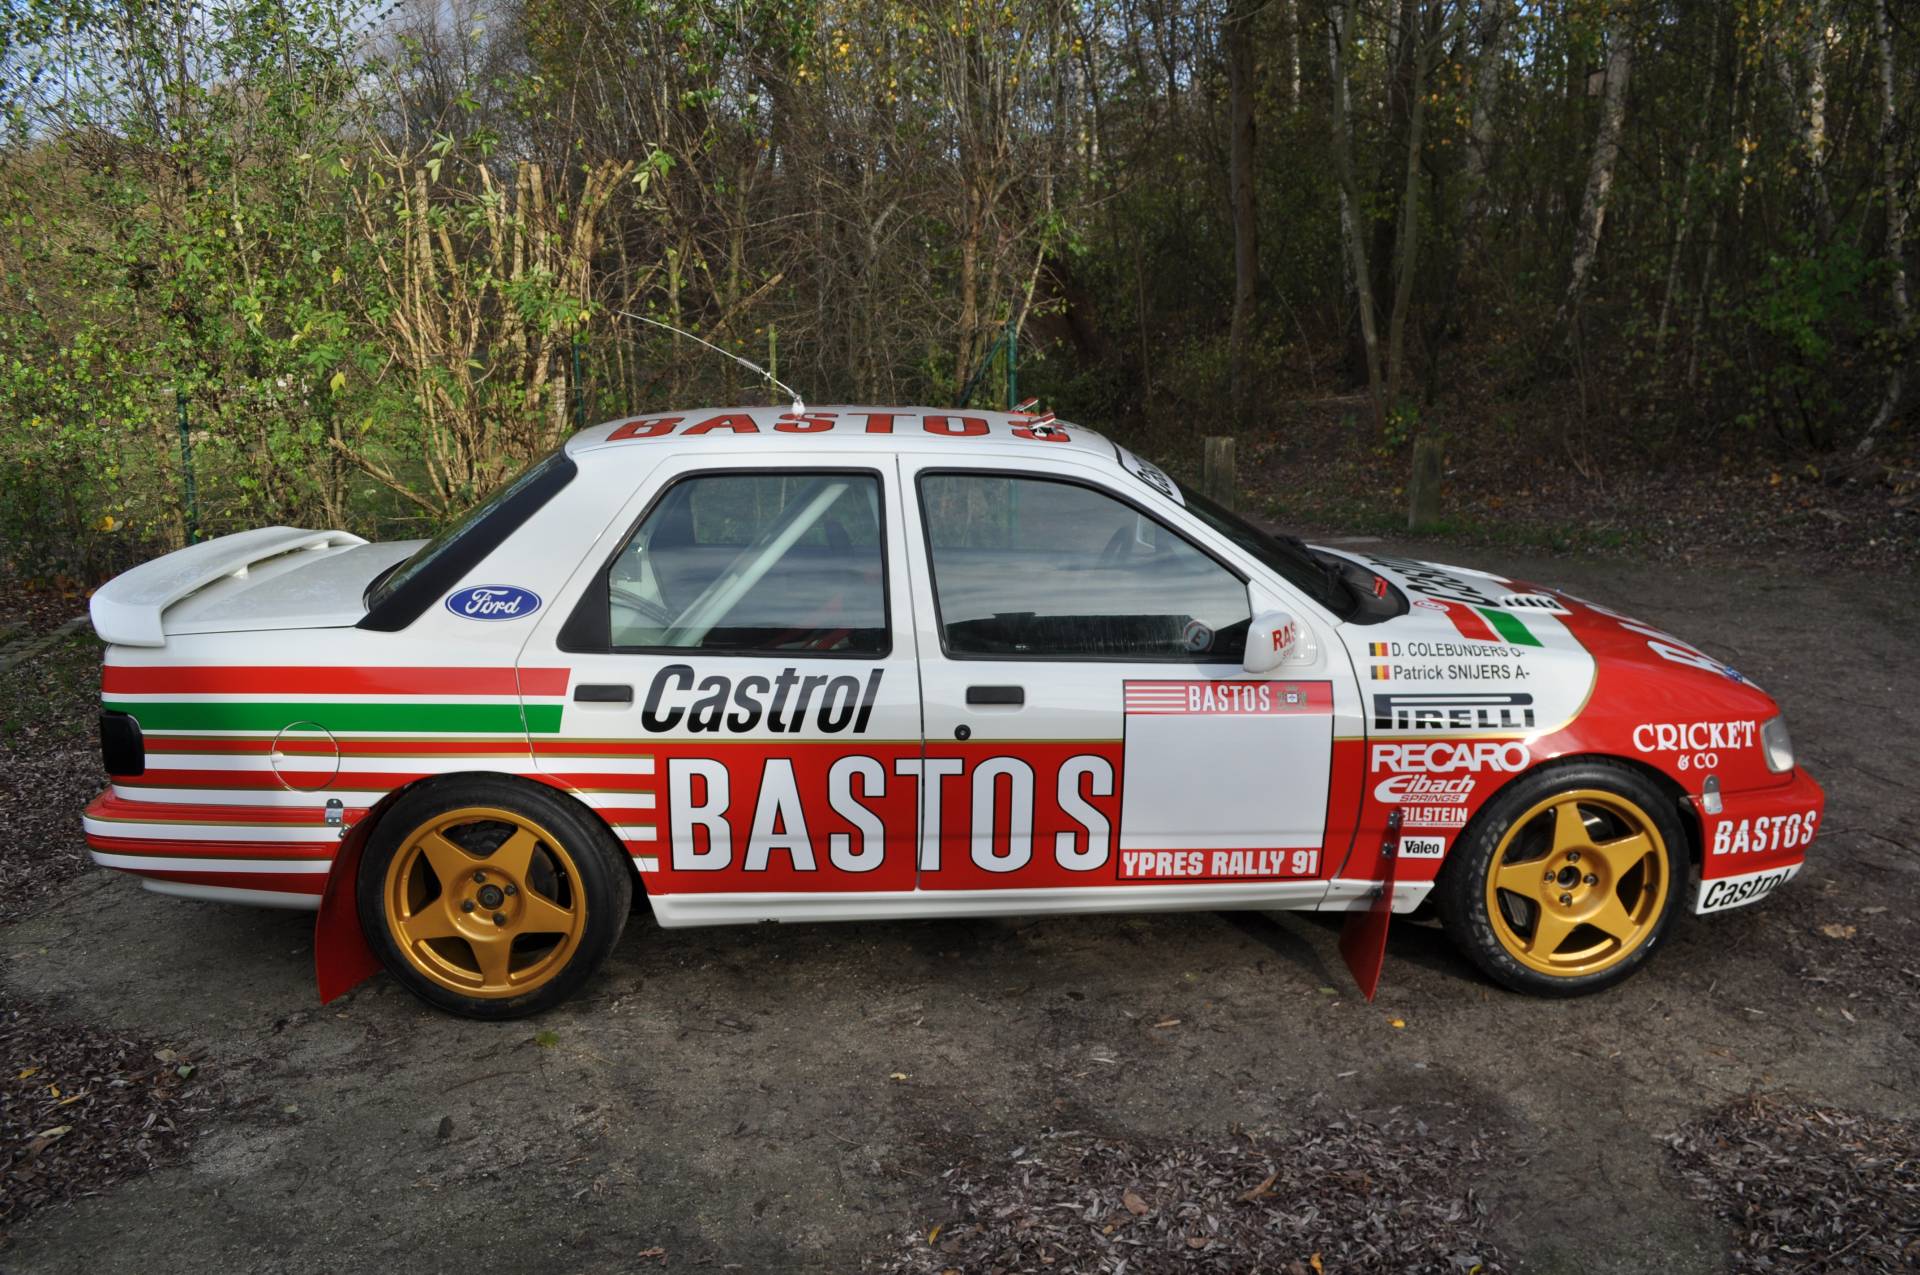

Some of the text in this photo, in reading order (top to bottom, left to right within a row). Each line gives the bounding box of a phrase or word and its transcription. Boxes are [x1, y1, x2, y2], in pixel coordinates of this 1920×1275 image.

[606, 412, 1072, 443] BASTOS
[465, 588, 522, 614] Ford
[1391, 642, 1404, 657] D.
[1408, 642, 1508, 657] COLEBUNDERS
[1393, 664, 1530, 680] Patrick SNIJERS A-
[641, 664, 884, 734] Castrol
[1188, 685, 1271, 712] BASTOS
[1373, 693, 1535, 729] PIRELLI
[1632, 720, 1756, 752] CRICKET
[1371, 742, 1531, 773] RECARO
[1677, 752, 1719, 771] & CO
[1374, 774, 1476, 803] Eibach
[1400, 794, 1461, 802] SPRINGS
[666, 754, 1114, 873] BASTOS
[1400, 807, 1468, 822] BILSTEIN
[1712, 810, 1817, 855] BASTOS
[1404, 840, 1440, 854] Valeo
[1123, 850, 1318, 877] YPRES RALLY 91
